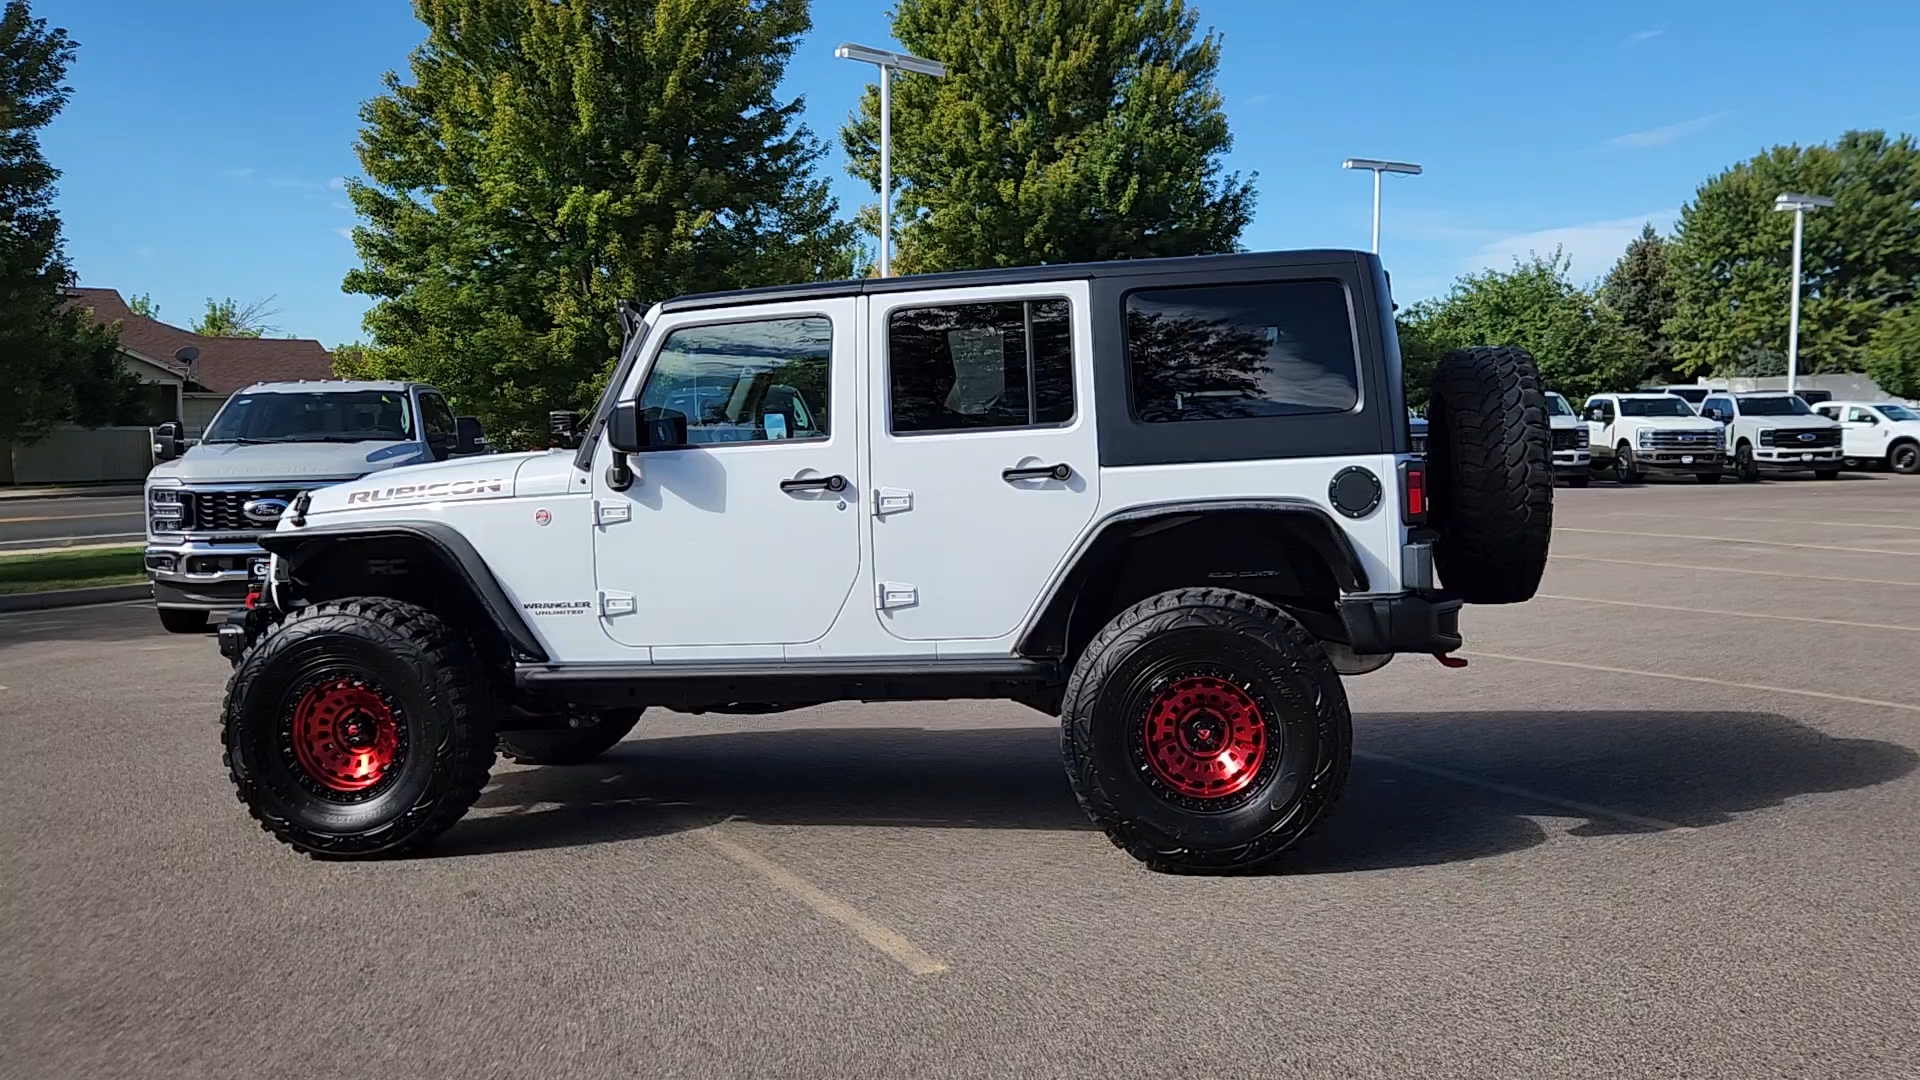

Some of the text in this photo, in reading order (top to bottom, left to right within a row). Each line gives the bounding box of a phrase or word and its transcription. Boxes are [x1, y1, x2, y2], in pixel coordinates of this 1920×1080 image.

[347, 478, 503, 504] RUBICON
[256, 504, 280, 515] Ford
[523, 601, 592, 609] WRANGLER
